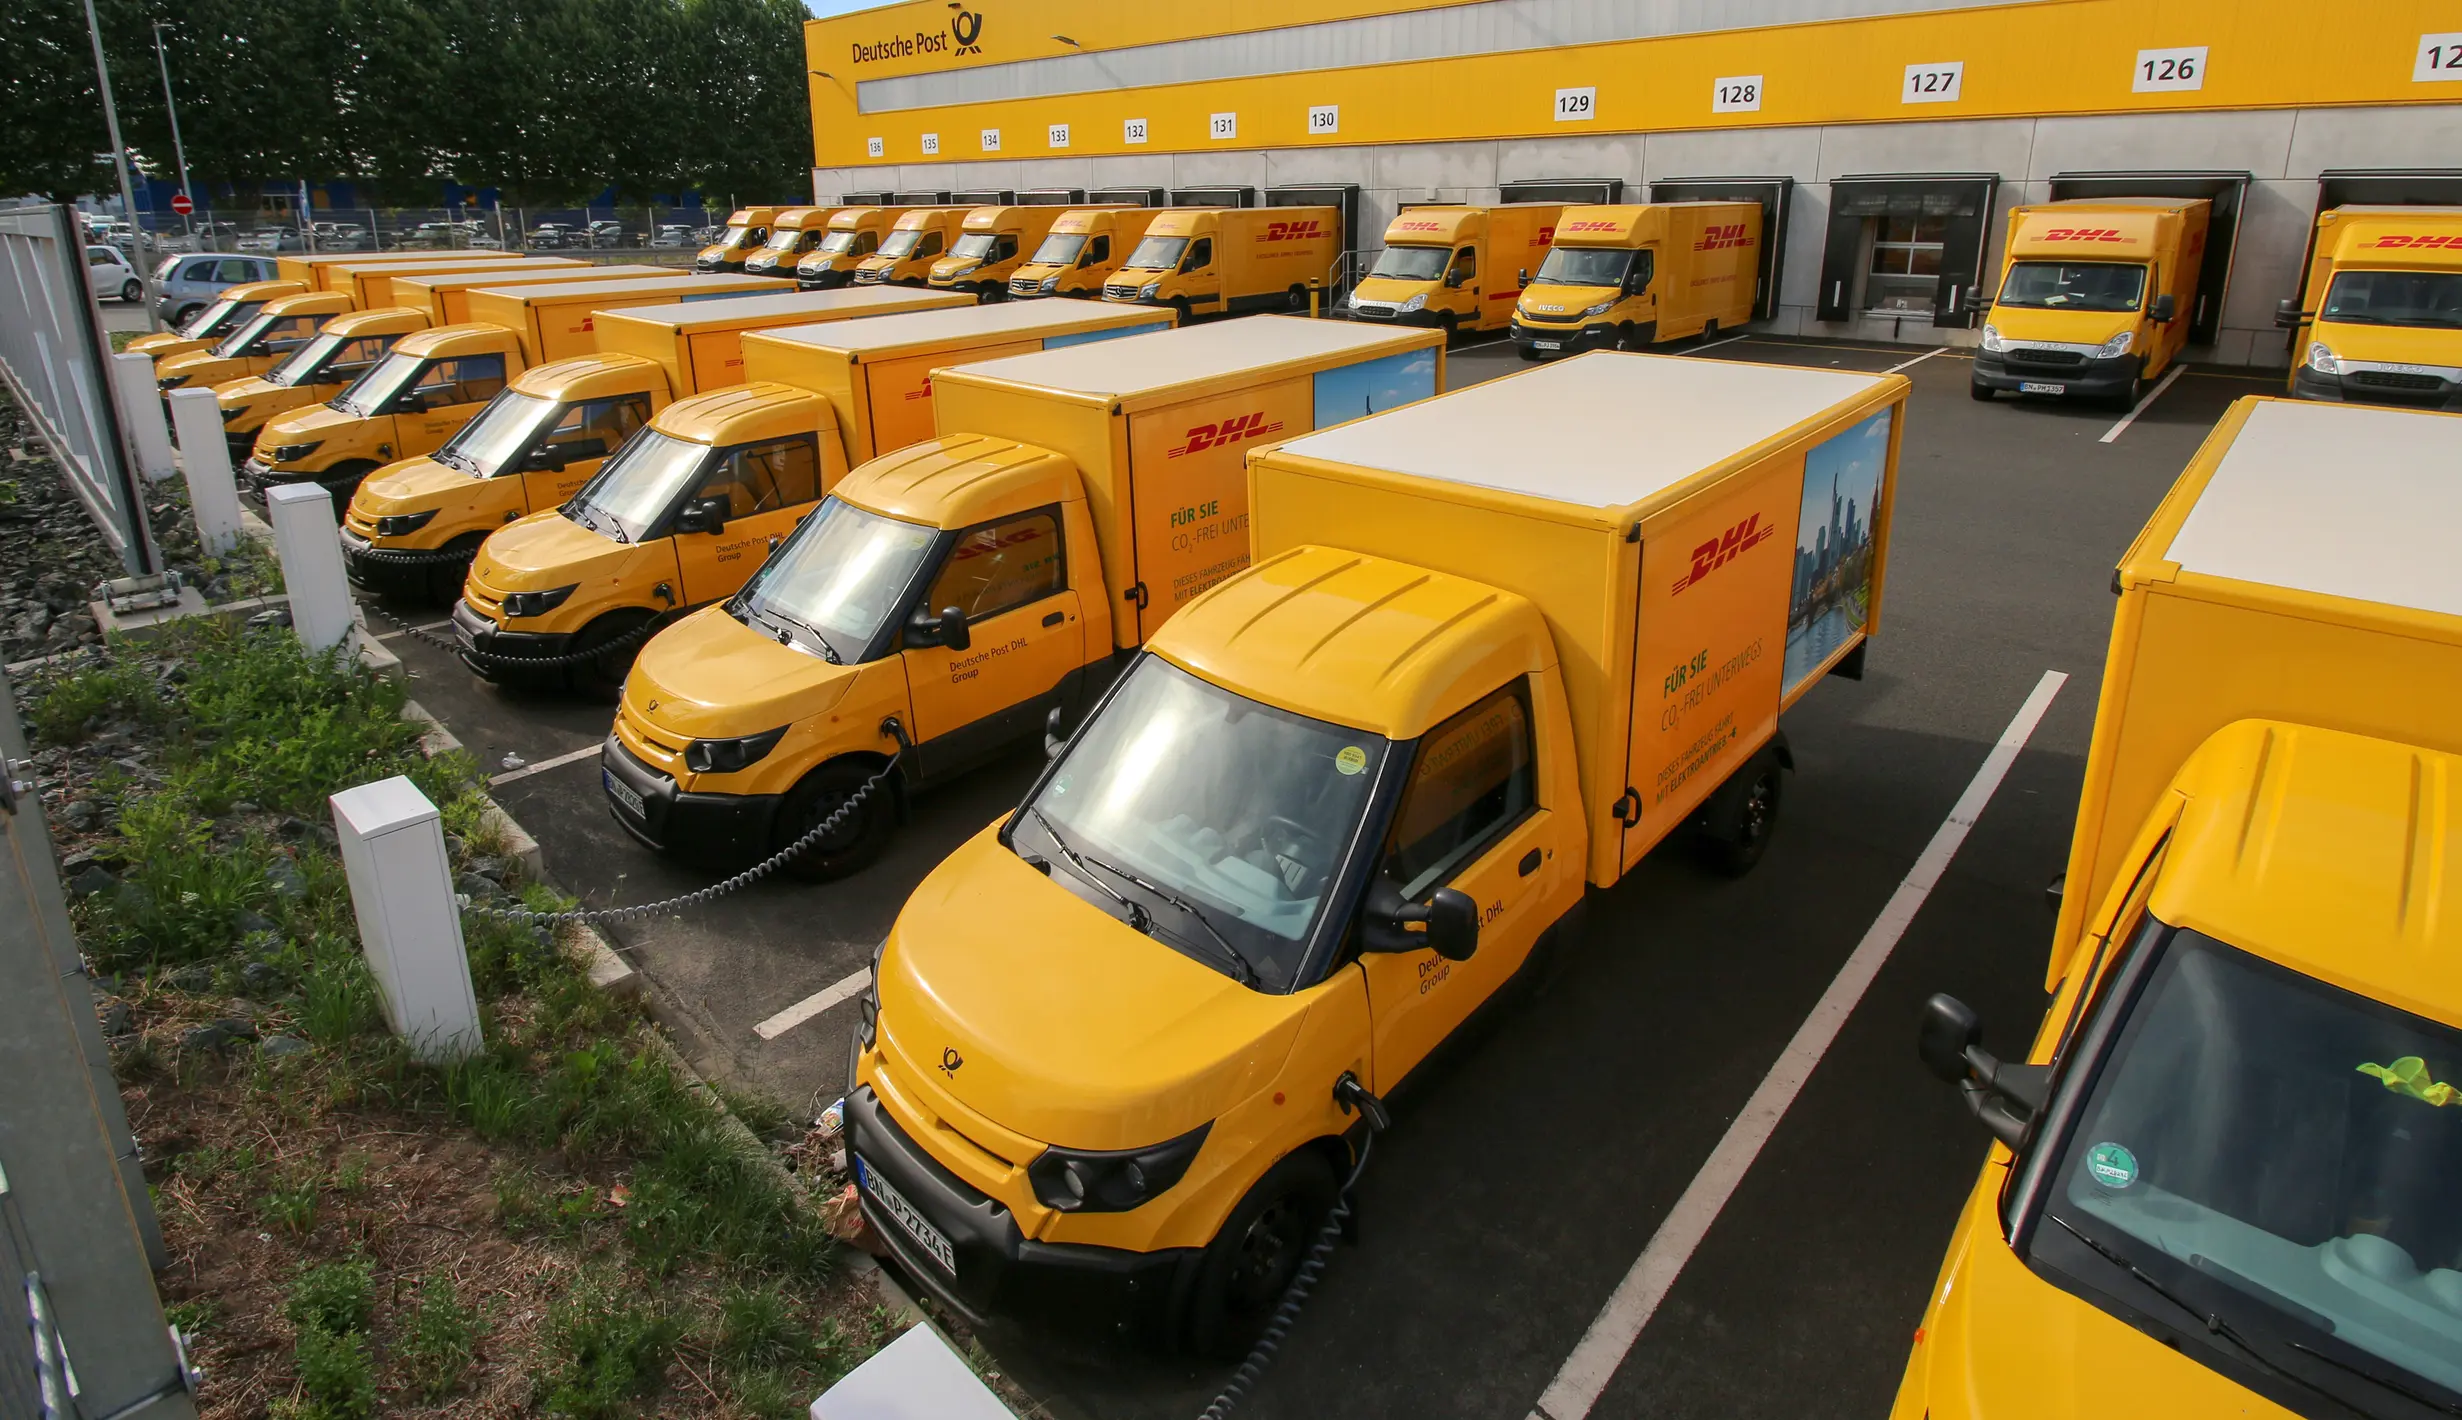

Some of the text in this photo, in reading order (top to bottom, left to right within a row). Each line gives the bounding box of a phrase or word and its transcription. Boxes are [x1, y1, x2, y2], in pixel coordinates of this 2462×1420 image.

[852, 30, 947, 63] Deutsche Post
[2143, 57, 2195, 82] 126
[1912, 72, 1955, 93] 127
[1720, 84, 1755, 104] 128
[1559, 95, 1589, 113] 129
[1214, 119, 1232, 133] 131
[1312, 112, 1334, 127] 130
[983, 134, 997, 146] 134
[1051, 130, 1066, 142] 133
[1127, 125, 1144, 138] 132
[869, 142, 881, 153] 136
[924, 138, 936, 149] 135
[1267, 221, 1321, 241] DHL
[1401, 222, 1440, 231] DHL
[1569, 222, 1617, 232] DHL
[2044, 229, 2123, 242] DHL
[1703, 224, 1746, 250] DHL
[1538, 304, 1565, 312] IVECO
[1185, 412, 1268, 454] DHL
[1171, 500, 1218, 528] FÜR SIE
[716, 540, 751, 554] Deutsche
[751, 535, 769, 546] Post
[1687, 512, 1761, 587] DHL
[718, 552, 741, 563] Group
[1173, 572, 1198, 589] DIESES
[1174, 589, 1188, 601] MIT
[950, 637, 1028, 672] Deutsche Post DHL
[1664, 649, 1708, 699] FÜR SIE
[1707, 637, 1762, 696] UNTERWEGS
[952, 668, 979, 684] Group
[1486, 899, 1504, 923] DHL
[1420, 964, 1450, 995] Group
[2107, 1149, 2119, 1167] 4
[865, 1167, 885, 1202] BN
